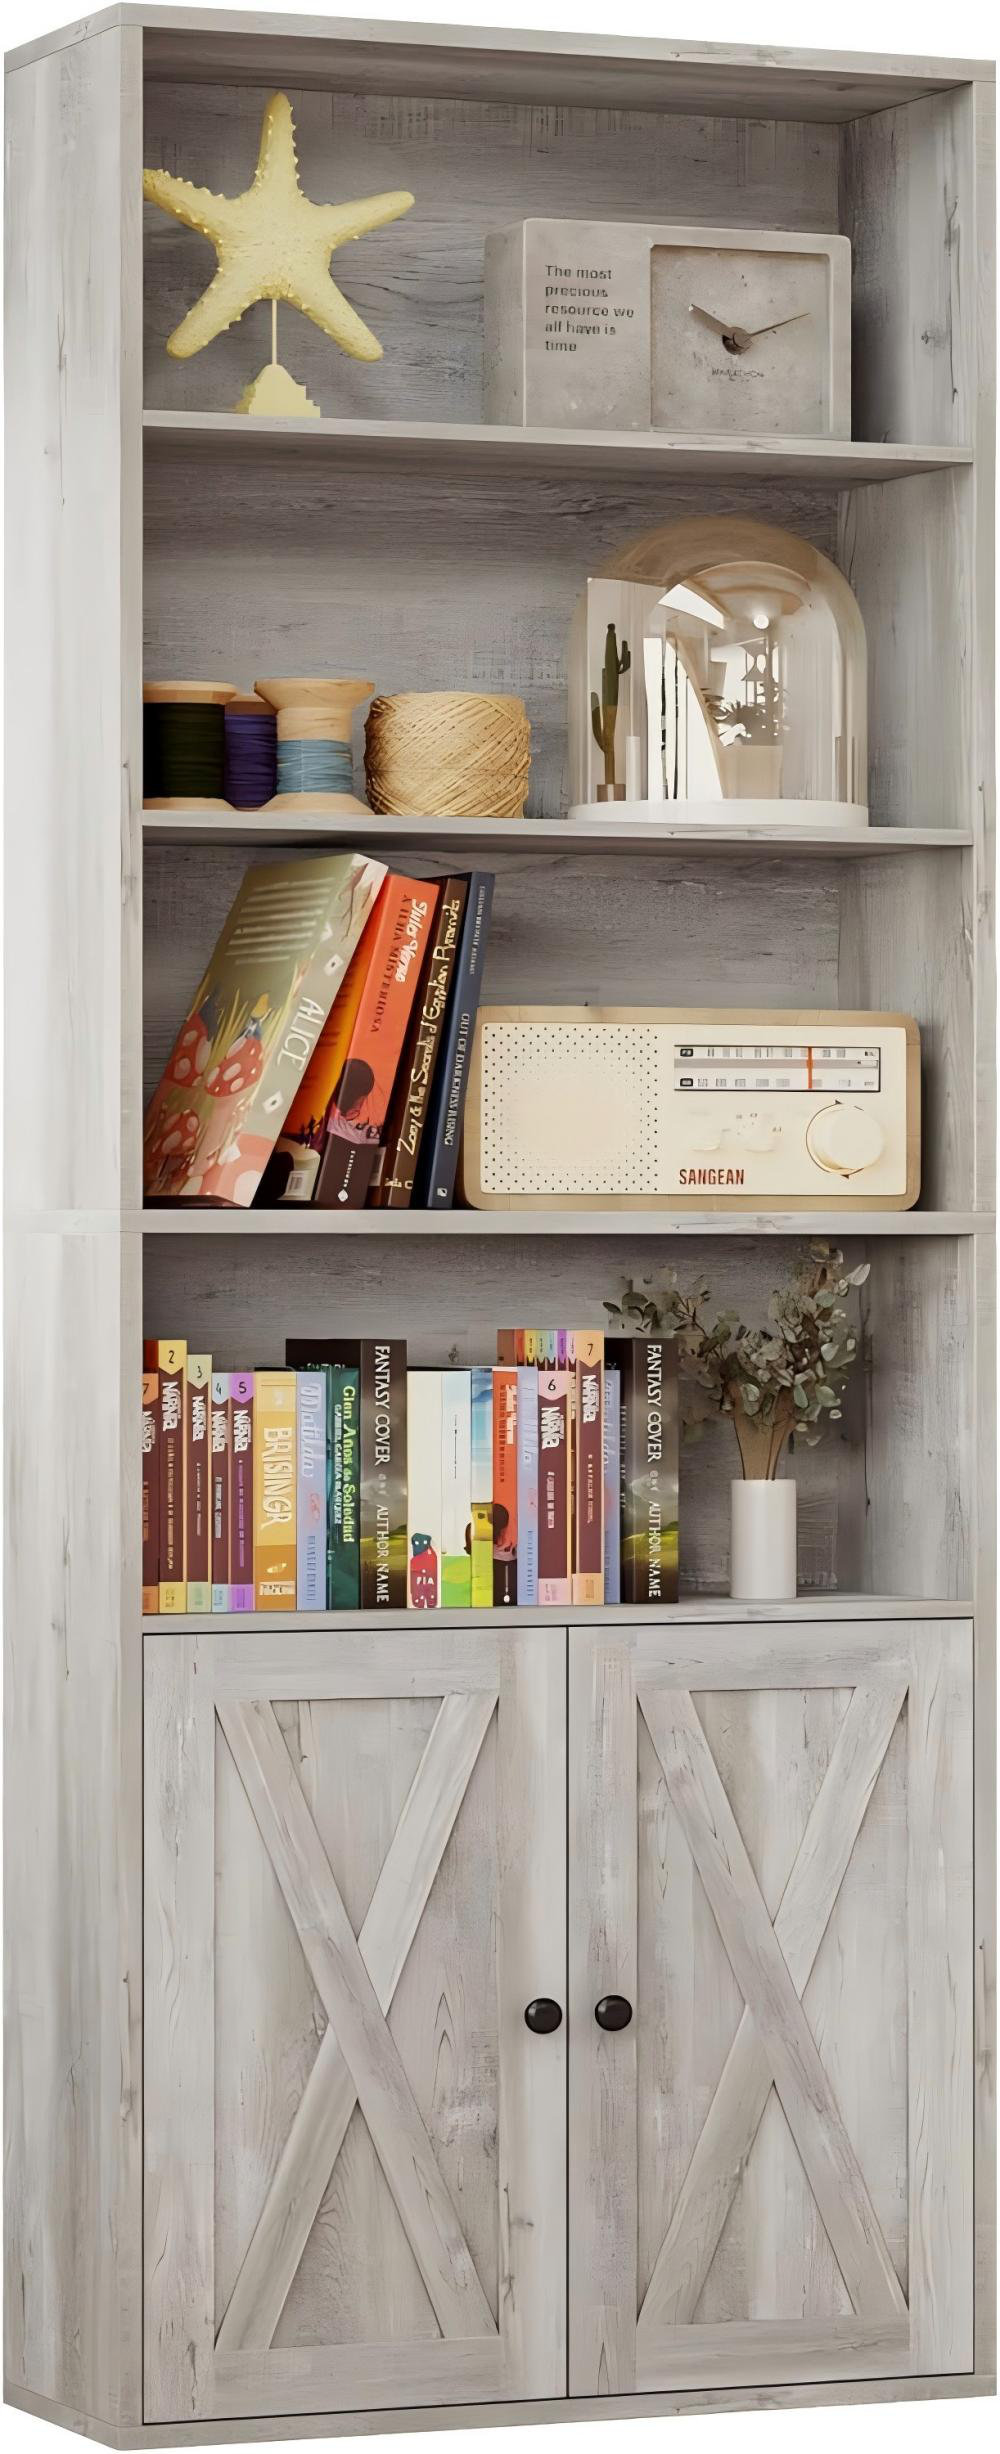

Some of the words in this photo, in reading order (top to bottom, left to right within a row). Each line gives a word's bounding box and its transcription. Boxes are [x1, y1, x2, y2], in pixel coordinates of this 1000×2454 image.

[545, 265, 571, 279] The
[576, 266, 612, 280] most
[545, 285, 609, 298] precious
[545, 303, 609, 317] resource
[613, 308, 635, 318] we
[545, 322, 563, 333] all
[566, 320, 601, 335] have
[604, 323, 616, 336] is
[545, 340, 577, 352] time
[277, 996, 325, 1071] ALICE
[679, 1168, 745, 1185] SANGEAN
[168, 1350, 175, 1364] 2
[587, 1343, 594, 1356] 7
[196, 1365, 203, 1379] 3
[374, 1345, 391, 1410] FANTASY
[647, 1344, 662, 1408] FANTASY
[215, 1382, 222, 1395] 4
[238, 1381, 247, 1394] 5
[547, 1379, 556, 1391] 6
[374, 1413, 391, 1466] COVER
[647, 1411, 662, 1463] COVER
[261, 1426, 294, 1531] BRISINGR
[375, 1503, 390, 1565] AUTHOR
[647, 1499, 662, 1556] AUTHOR
[375, 1563, 390, 1603] NAME
[648, 1557, 662, 1598] NAME
